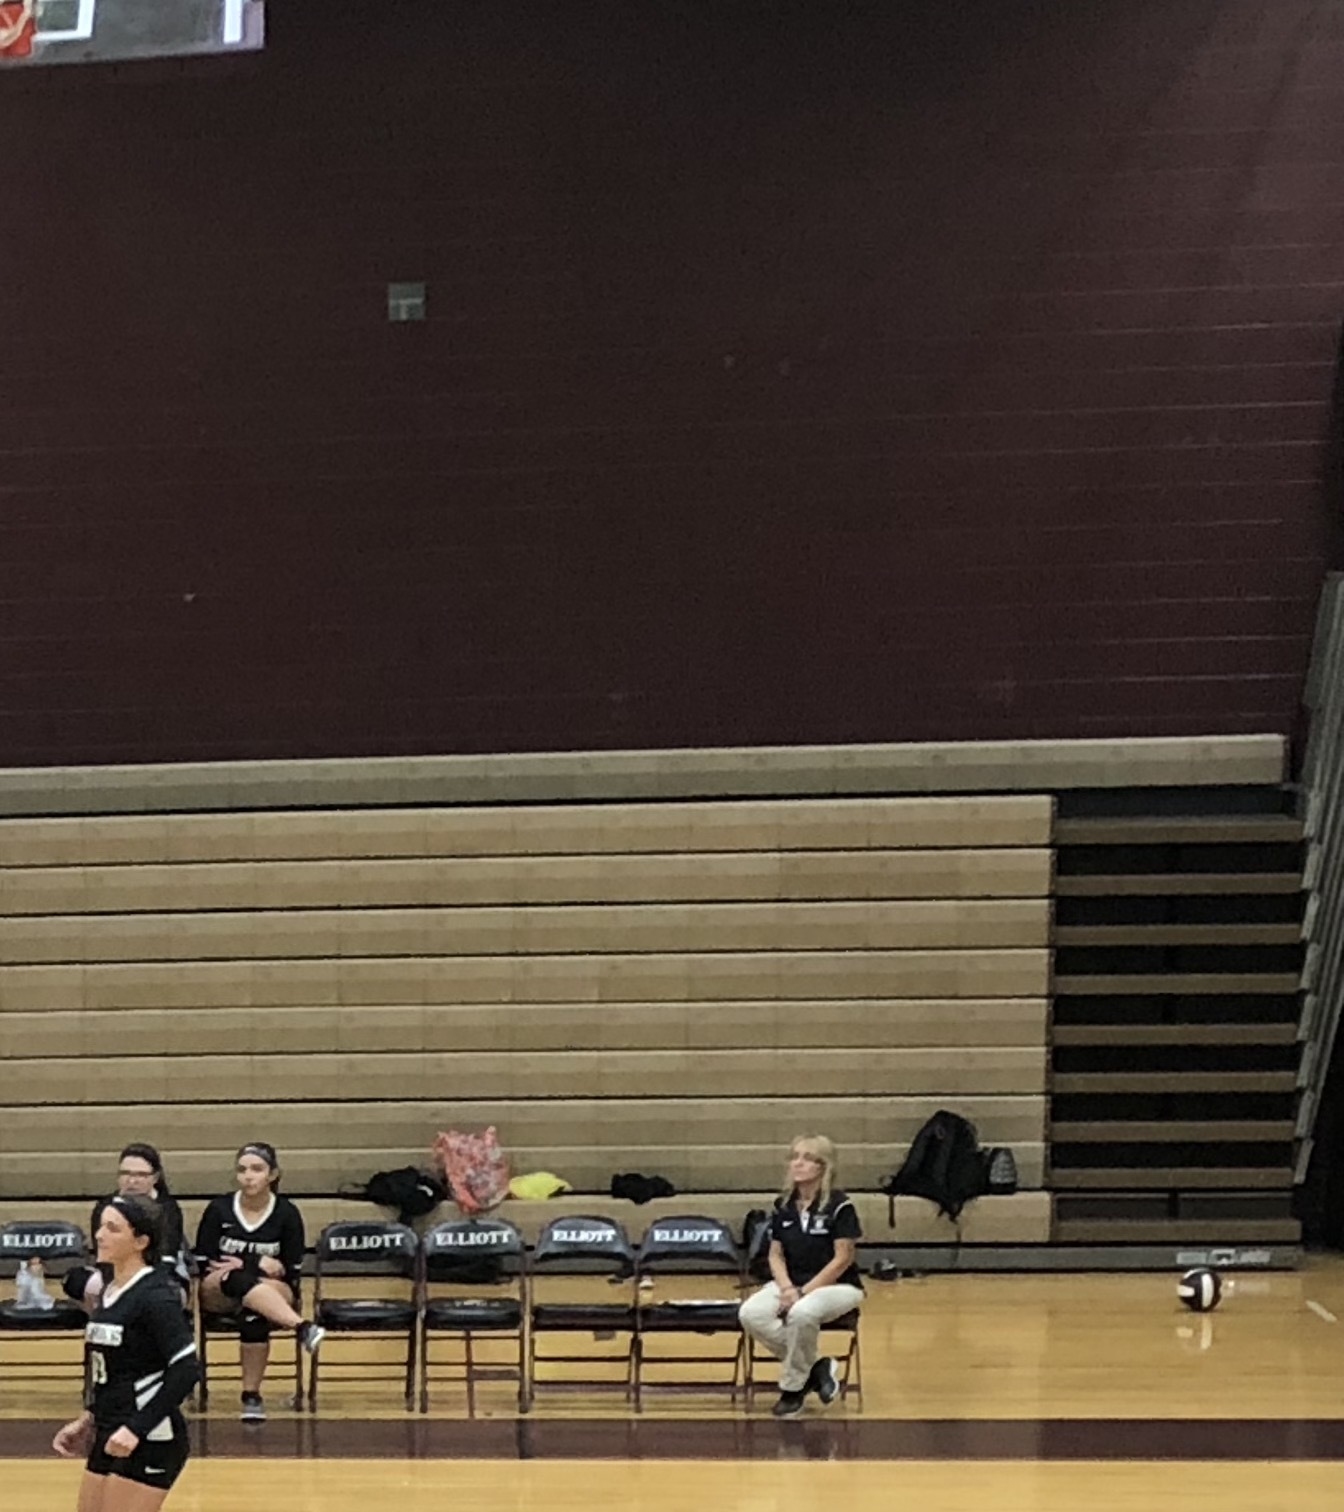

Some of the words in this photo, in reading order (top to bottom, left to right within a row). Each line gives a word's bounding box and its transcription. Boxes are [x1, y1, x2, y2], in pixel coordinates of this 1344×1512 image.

[3, 1233, 75, 1248] ELLIOTT
[329, 1233, 406, 1250] ELLIOTT
[435, 1230, 513, 1246] ELLIOTT
[552, 1229, 617, 1242] ELLIOTT
[653, 1229, 723, 1242] ELLIOTT
